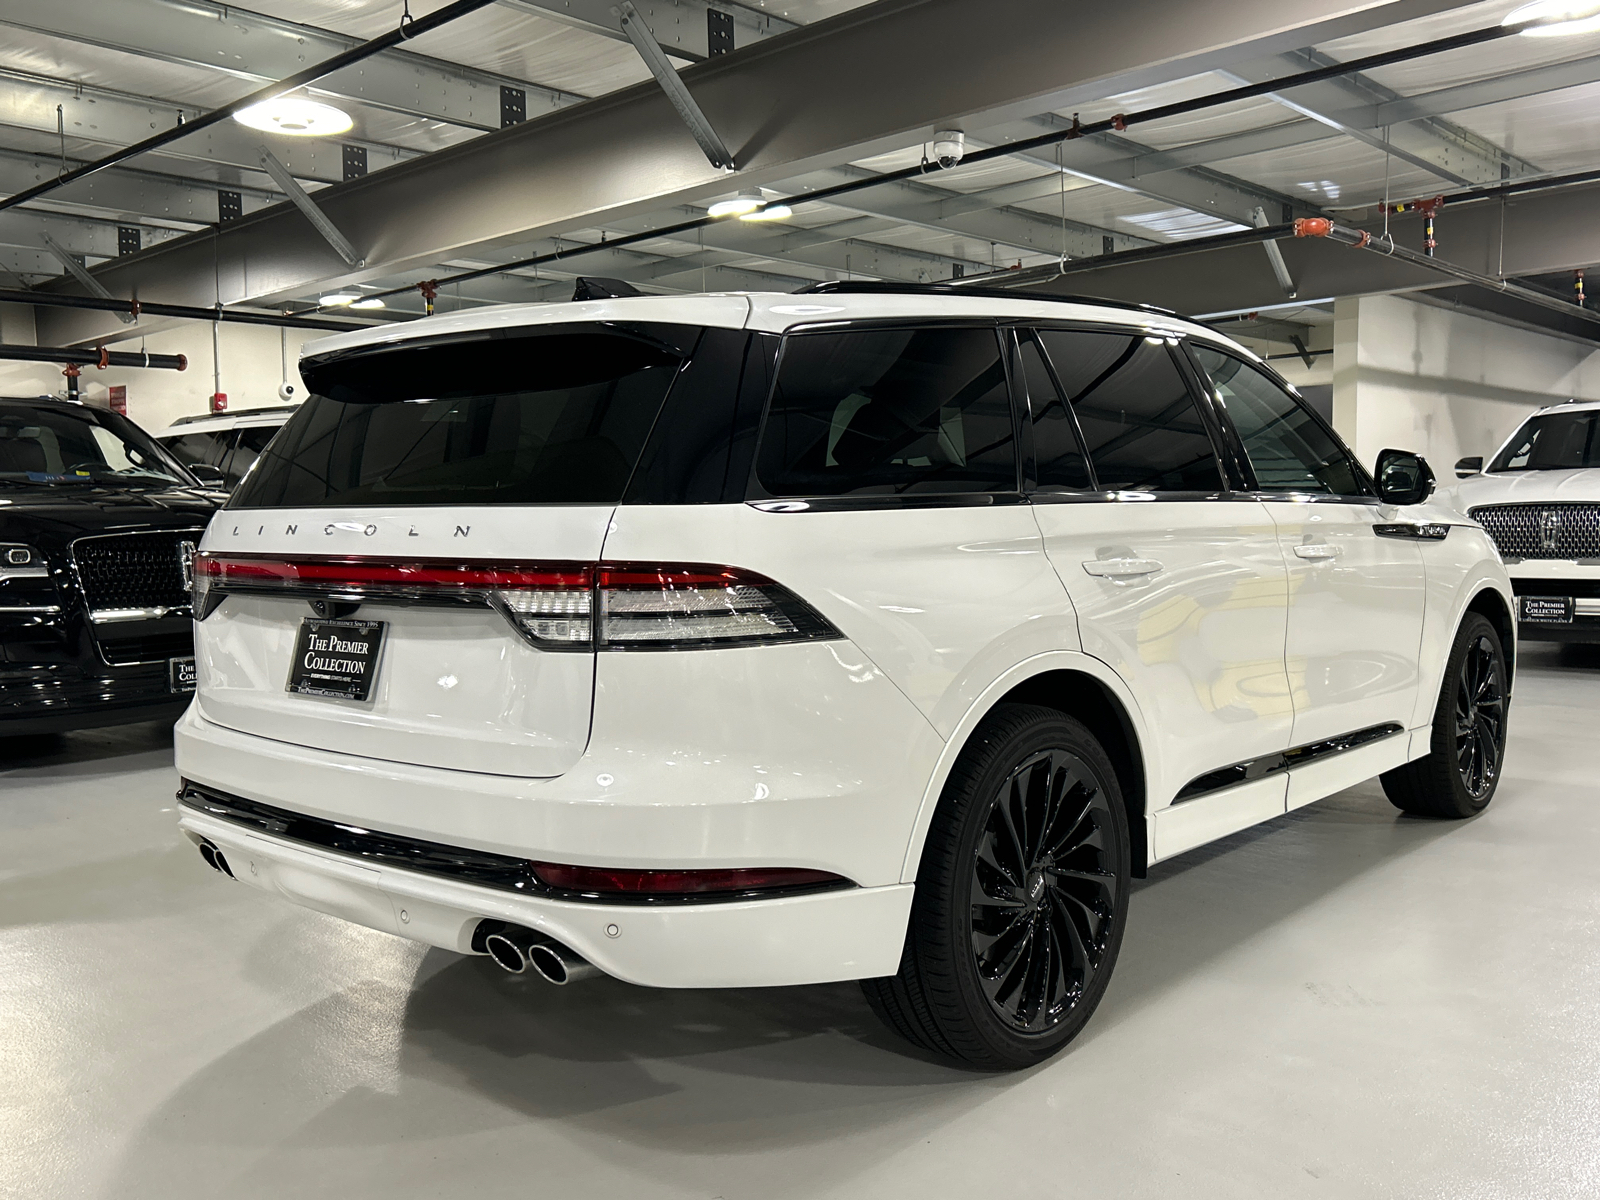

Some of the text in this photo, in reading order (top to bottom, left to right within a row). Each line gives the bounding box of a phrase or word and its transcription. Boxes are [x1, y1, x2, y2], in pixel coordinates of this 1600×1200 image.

[232, 524, 471, 538] LINCOLN
[308, 633, 369, 655] THE PREMIER
[179, 664, 194, 672] THE
[304, 651, 366, 674] COLLECTION
